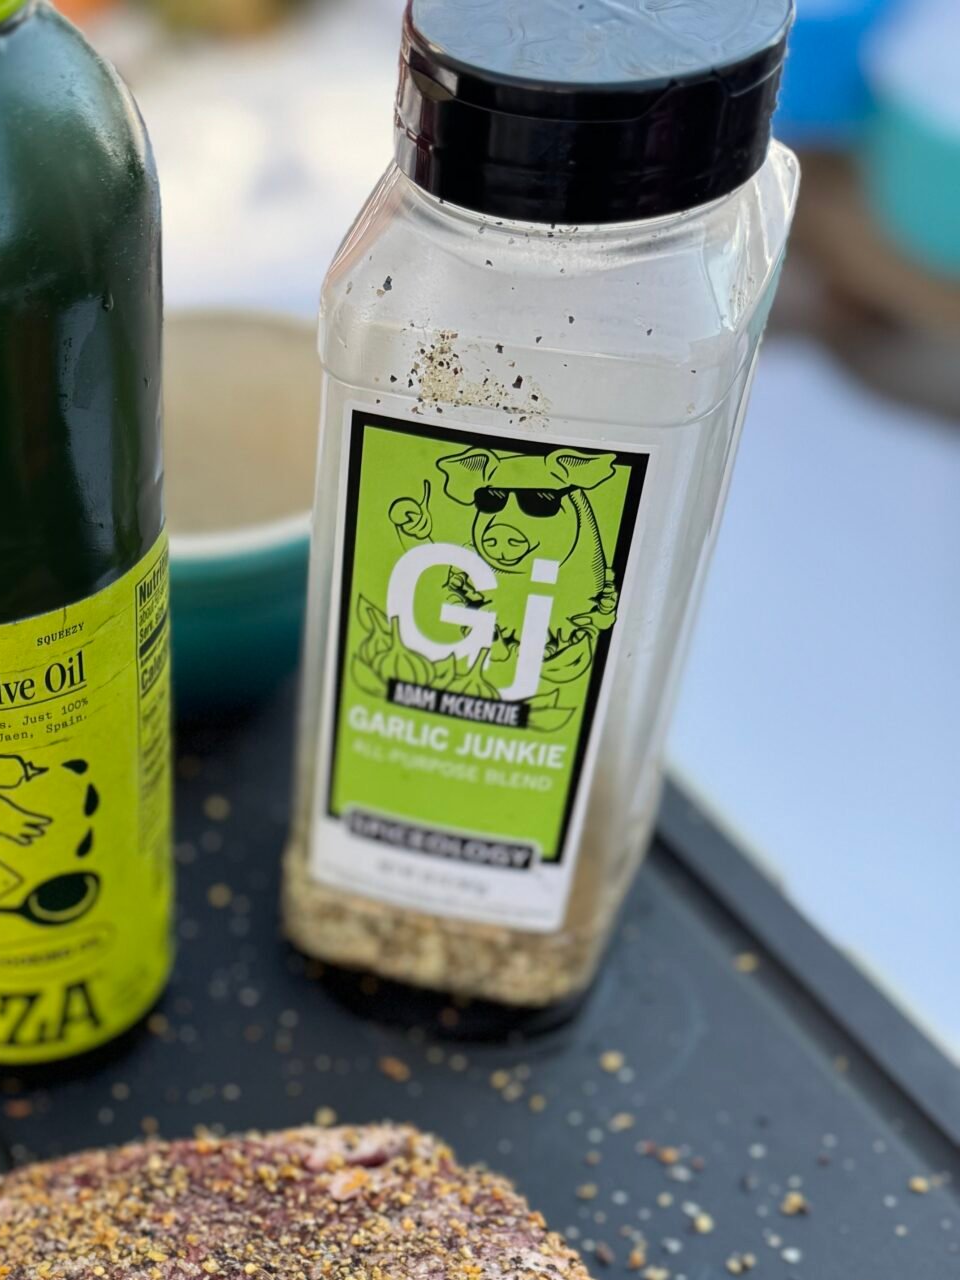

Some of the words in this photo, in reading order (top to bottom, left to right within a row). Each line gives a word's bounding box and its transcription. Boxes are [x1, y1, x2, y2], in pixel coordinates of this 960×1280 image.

[37, 622, 85, 646] SQUEEZY
[45, 650, 86, 693] Oil
[22, 711, 52, 726] Just
[61, 697, 88, 715] 100%
[46, 714, 87, 734] Spain.
[393, 682, 438, 711] ADAM
[440, 694, 520, 726] MCKENZIE
[348, 705, 449, 750] GARLIC
[455, 733, 567, 769] JUNKIE
[351, 738, 384, 763] ALL
[389, 747, 478, 784] PURPOSE
[484, 768, 552, 791] BLEND
